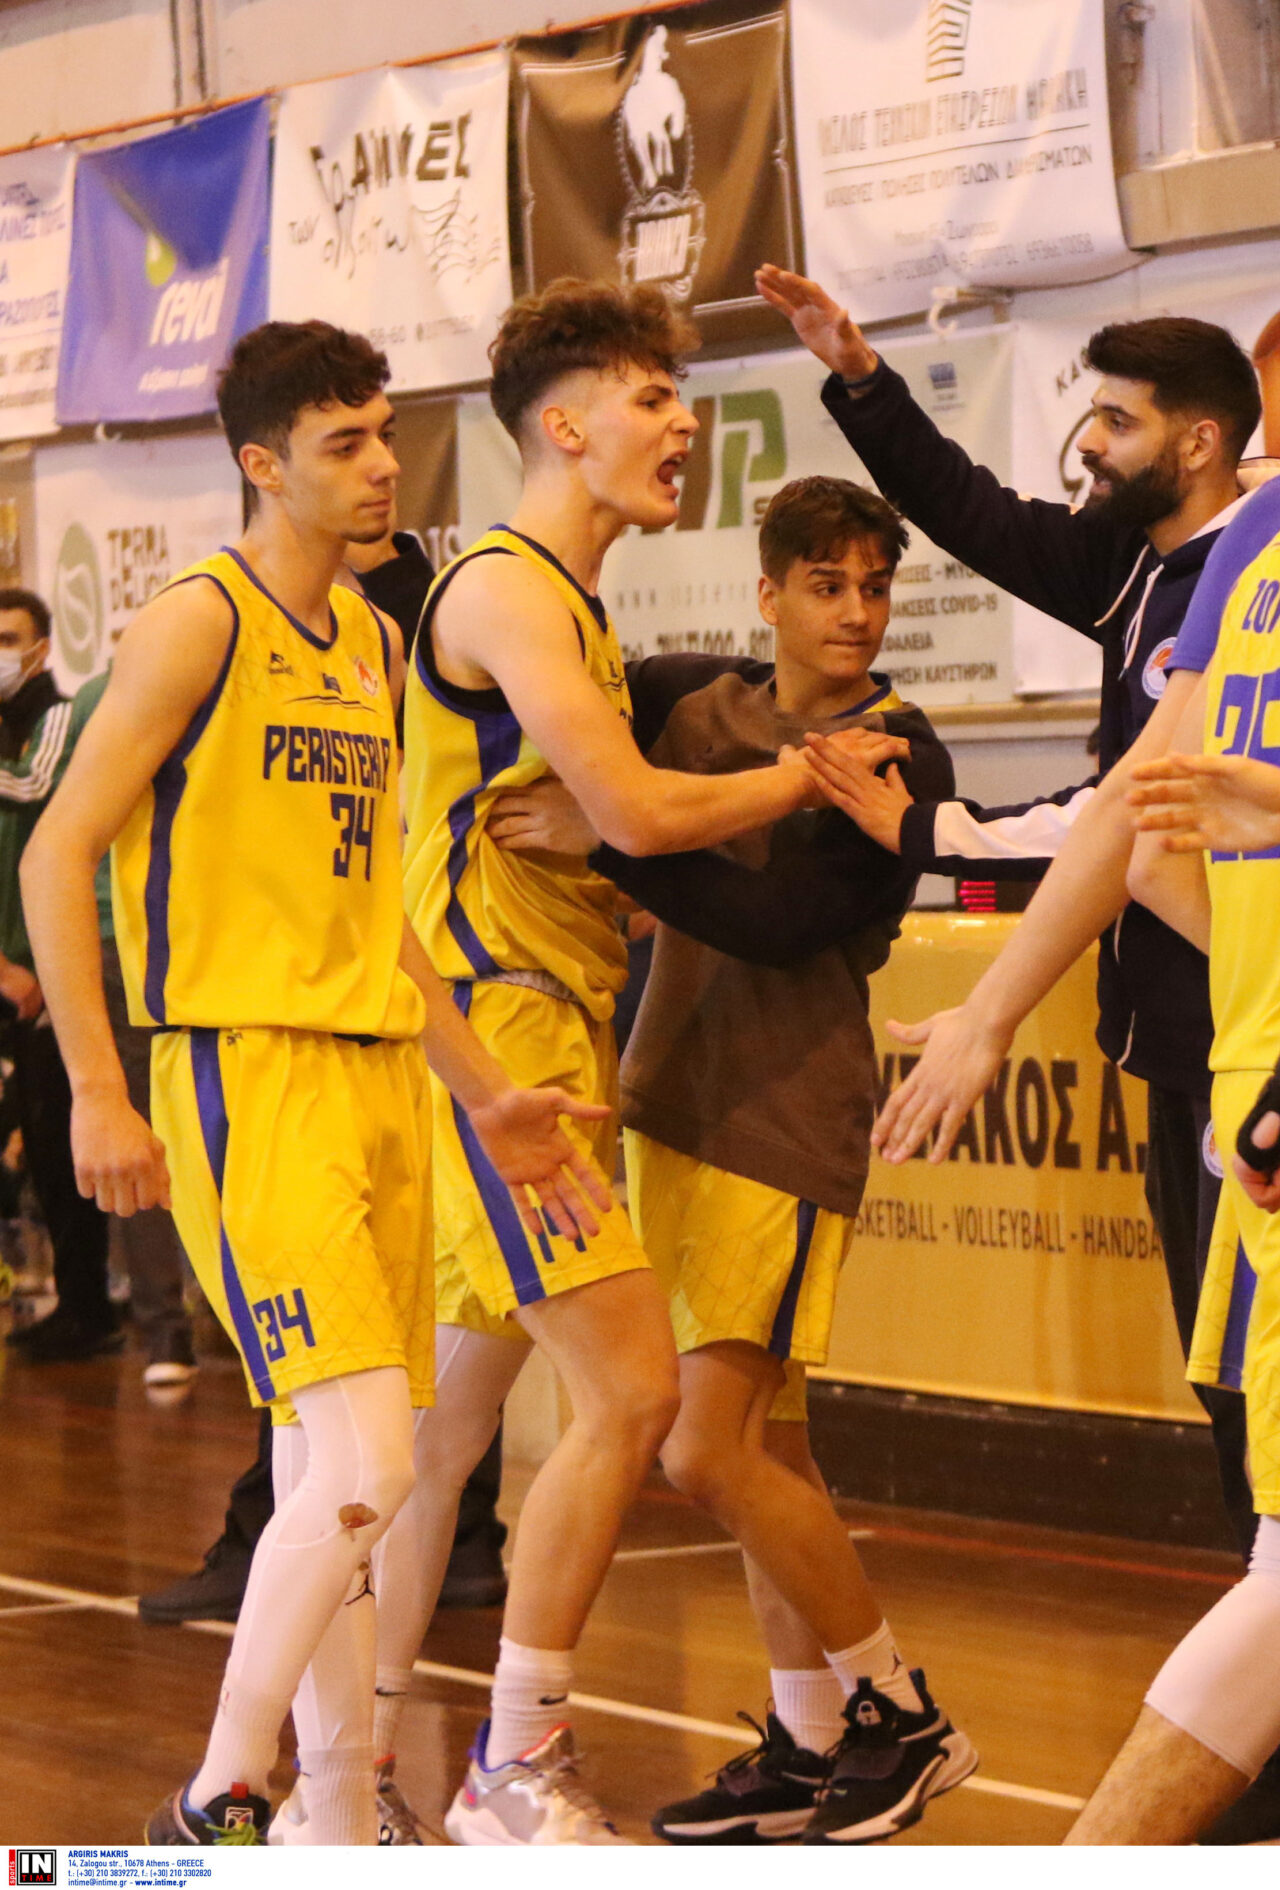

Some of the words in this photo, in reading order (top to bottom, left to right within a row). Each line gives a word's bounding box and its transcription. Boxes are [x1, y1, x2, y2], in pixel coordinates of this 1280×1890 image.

[330, 792, 374, 882] 34
[854, 1198, 937, 1243] SKETBALL
[954, 1204, 1066, 1254] VOLLEYBALL
[1083, 1214, 1164, 1261] HANDBA
[252, 1288, 316, 1363] 34
